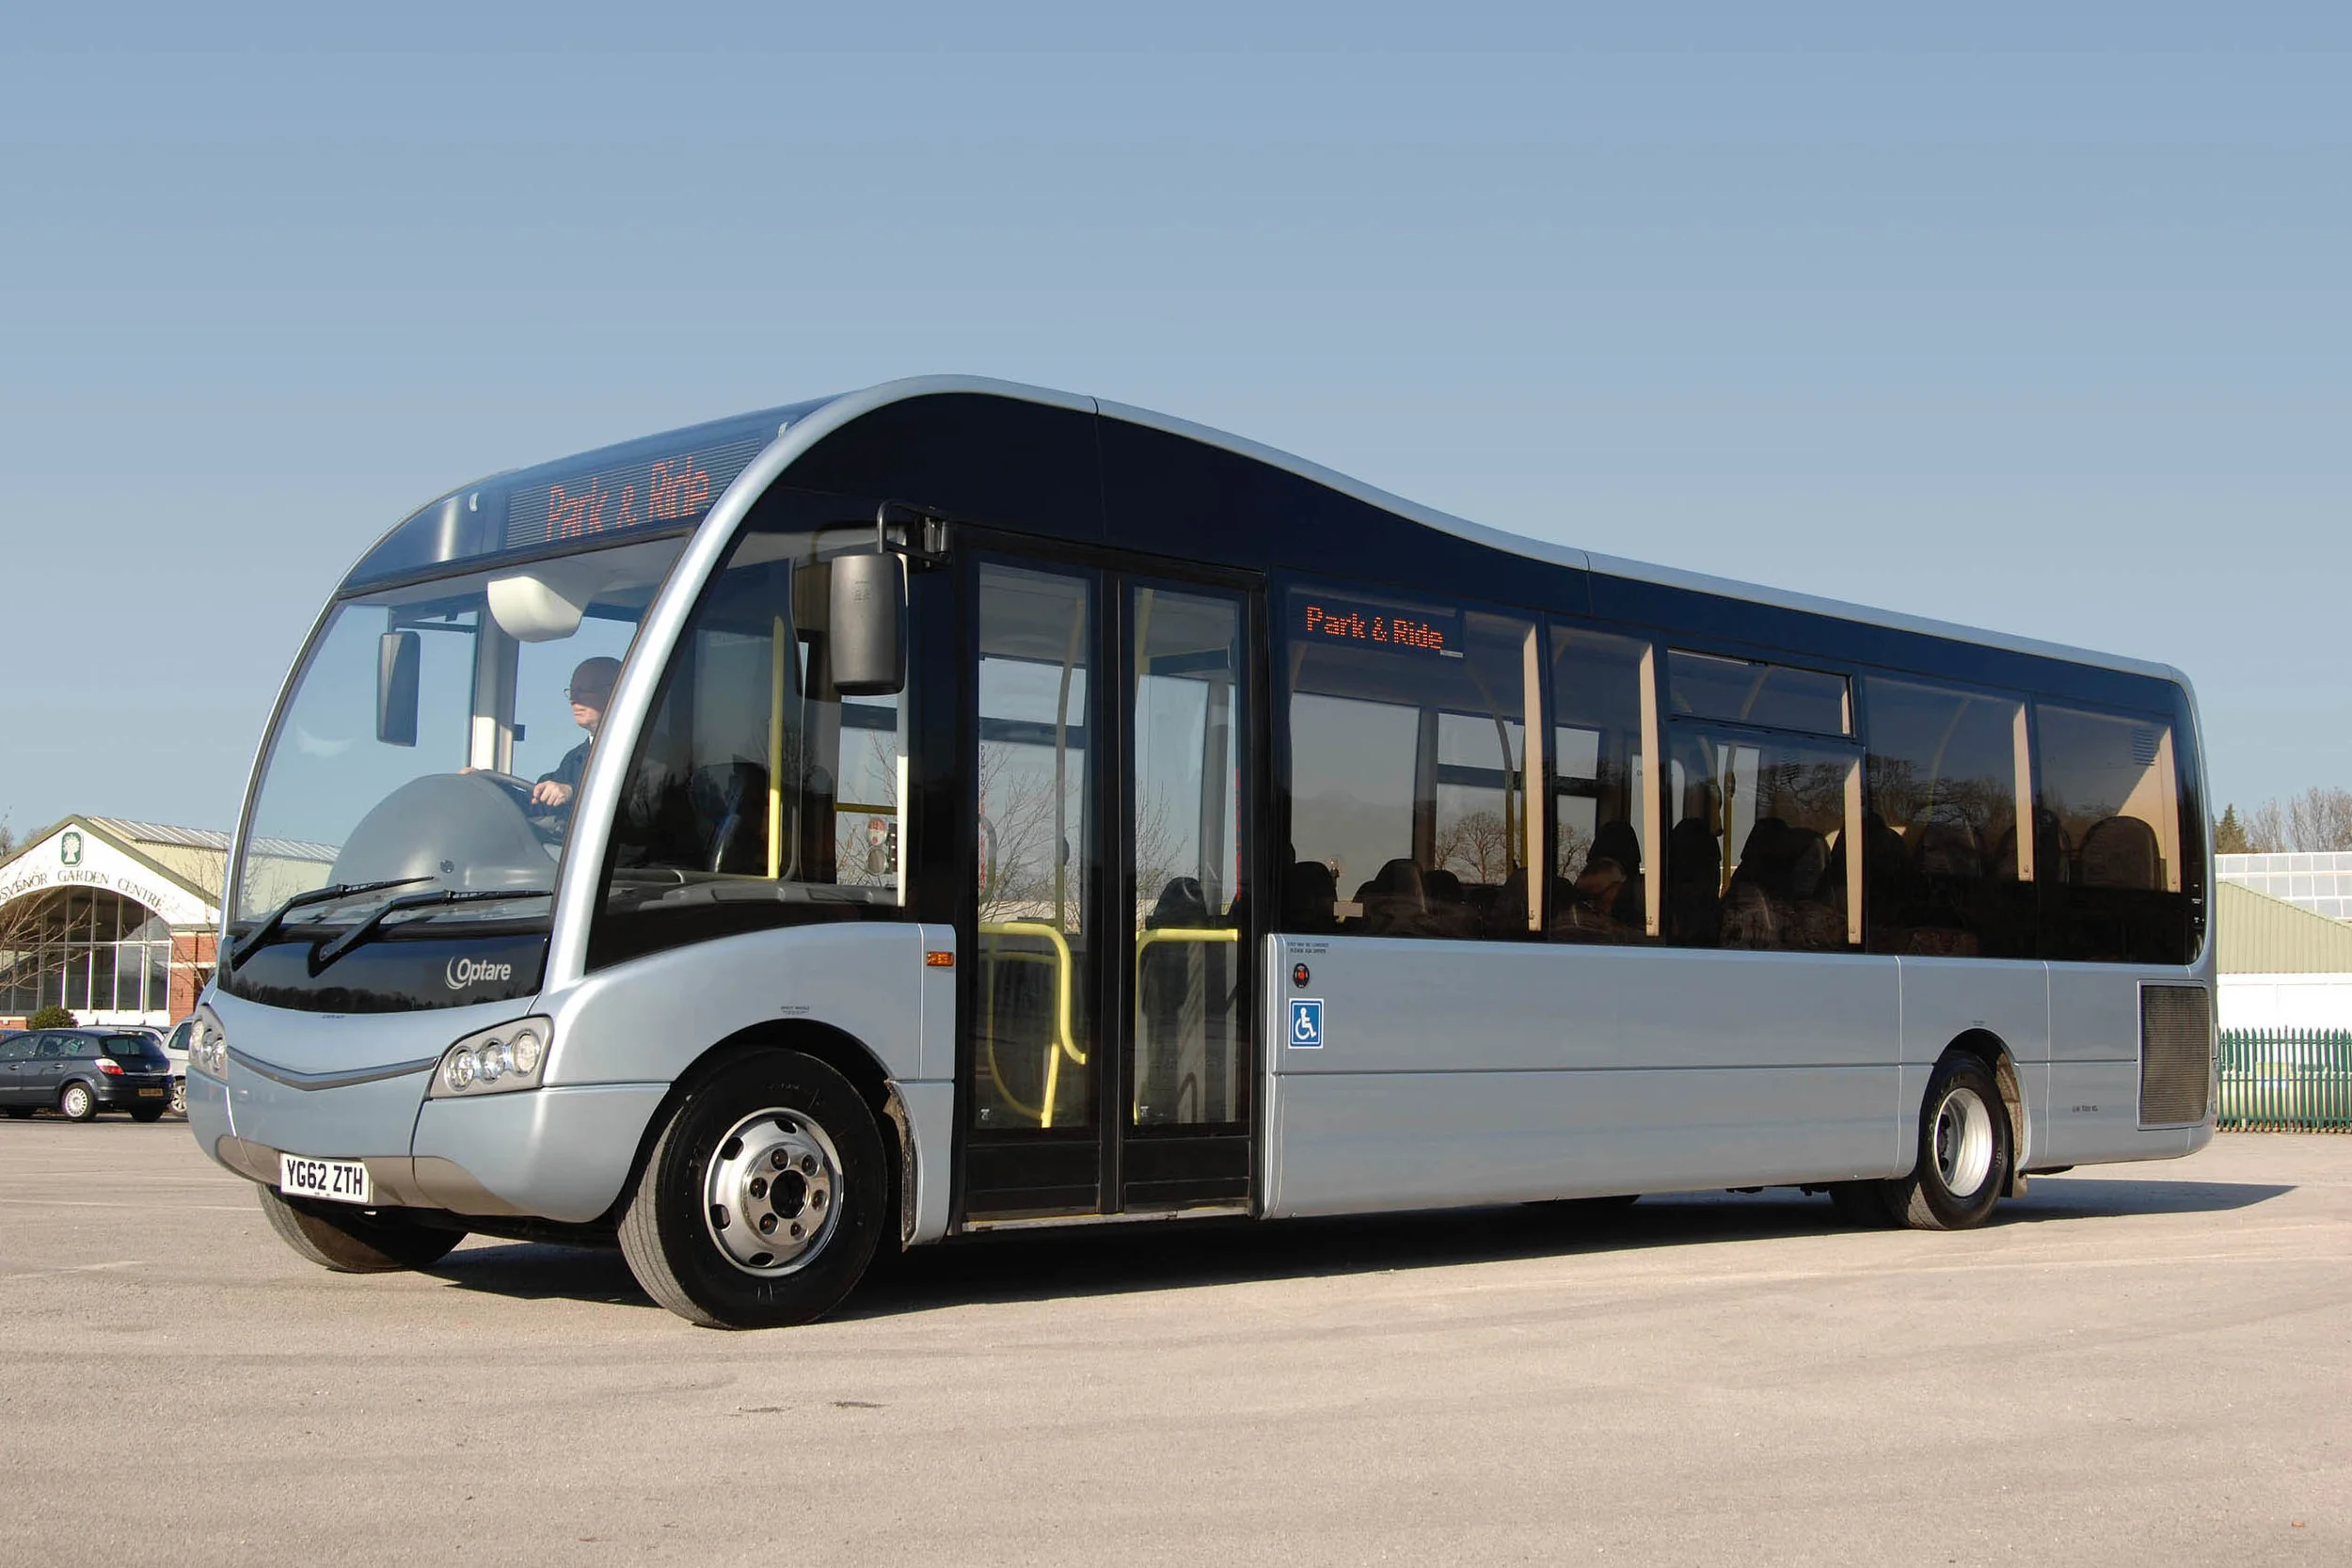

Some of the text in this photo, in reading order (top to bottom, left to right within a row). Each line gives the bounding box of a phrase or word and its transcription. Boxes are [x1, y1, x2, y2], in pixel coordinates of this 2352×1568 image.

[546, 456, 709, 542] Park & Ride
[1307, 606, 1444, 651] Park & Ride
[0, 869, 165, 911] SVENOR GARDEN CENTRE
[456, 958, 512, 987] Optare
[287, 1159, 363, 1196] YG62 ZTH
